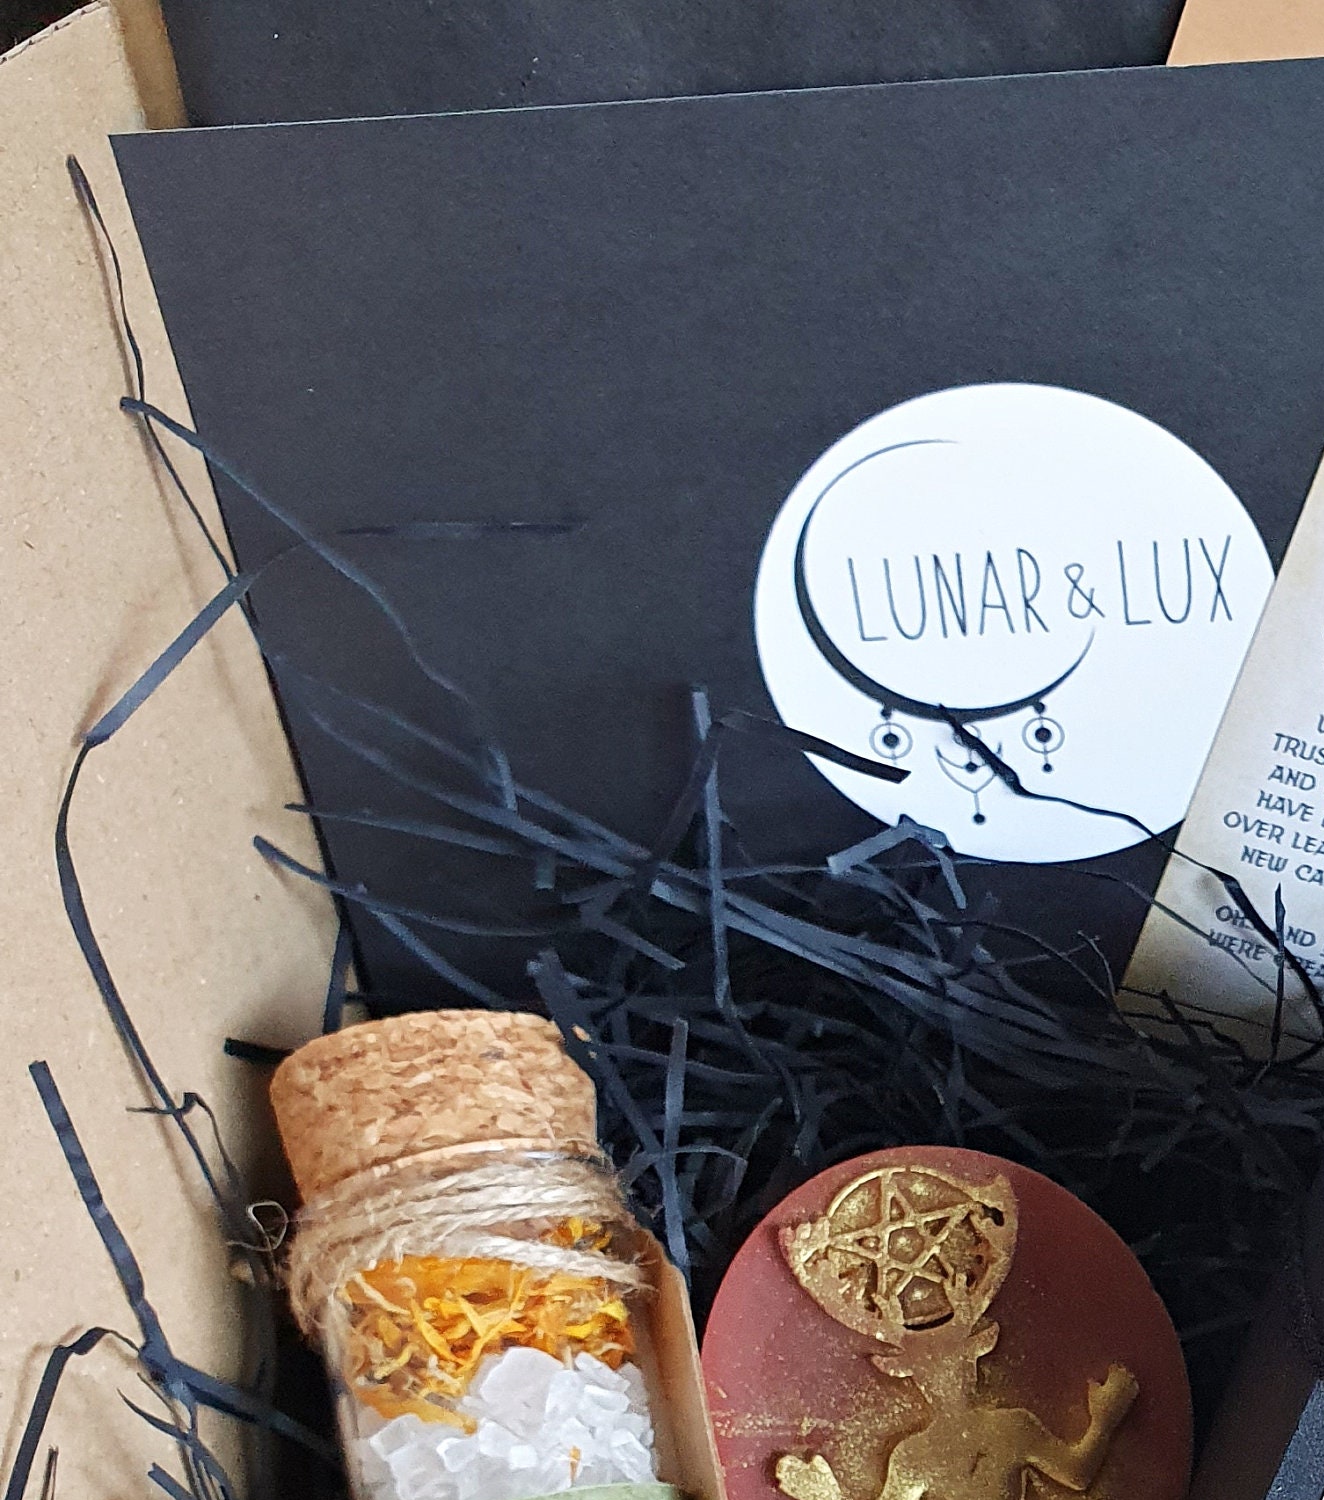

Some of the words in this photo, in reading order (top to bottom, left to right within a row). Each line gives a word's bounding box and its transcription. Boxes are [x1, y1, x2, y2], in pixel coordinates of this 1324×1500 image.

[847, 547, 1050, 642] LUNAR
[1064, 562, 1105, 619] &
[1117, 534, 1234, 626] LUX
[1267, 765, 1317, 791] AND
[1256, 790, 1314, 822] HAVE
[1223, 810, 1285, 845] OVER
[1239, 845, 1288, 873] NEW
[1209, 928, 1268, 962] WERE
[1280, 925, 1317, 948] ND
